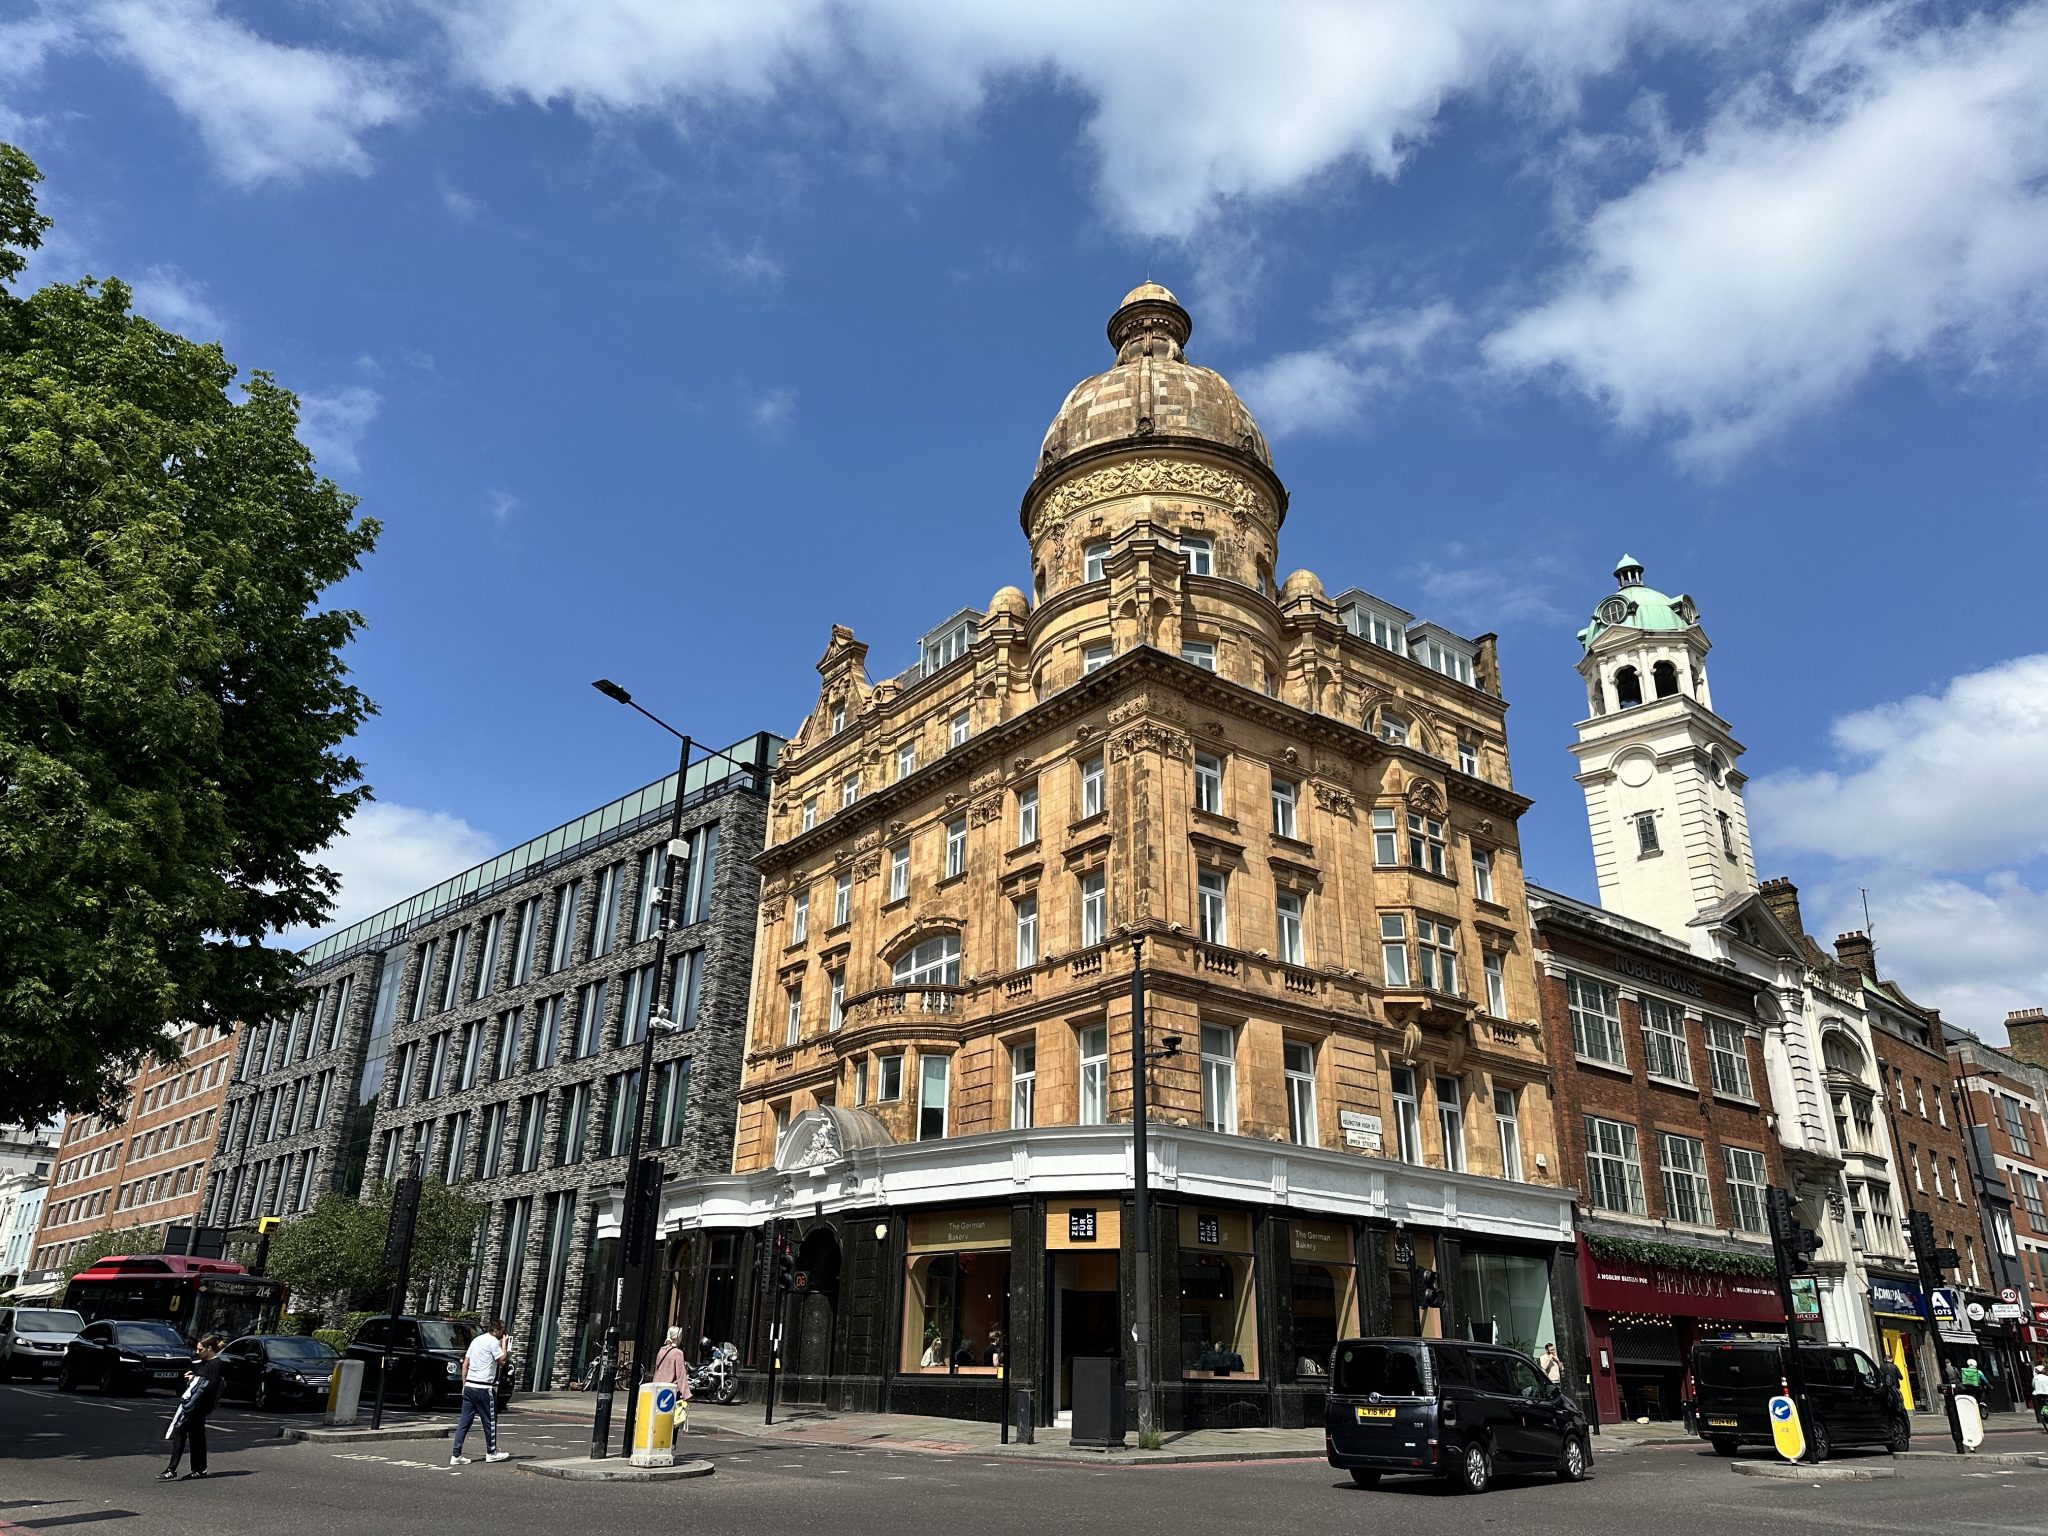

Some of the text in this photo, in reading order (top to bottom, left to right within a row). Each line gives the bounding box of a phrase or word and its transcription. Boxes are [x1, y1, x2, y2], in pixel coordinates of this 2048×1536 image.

[1615, 955, 1702, 997] NOBLE HOUSE
[1349, 1138, 1360, 1146] UPPER
[1362, 1140, 1377, 1149] STREET
[960, 1222, 985, 1230] German
[1071, 1216, 1079, 1236] ZEIT
[1086, 1213, 1094, 1236] BROT
[948, 1234, 969, 1242] Bakery
[1295, 1229, 1331, 1241] The German
[1295, 1240, 1317, 1252] Bakery
[214, 1281, 245, 1290] Moorgate
[1664, 1272, 1727, 1298] PEACOCK
[256, 1286, 271, 1297] 214
[1873, 1286, 1904, 1304] ADMIRAL
[2003, 1291, 2016, 1299] 20
